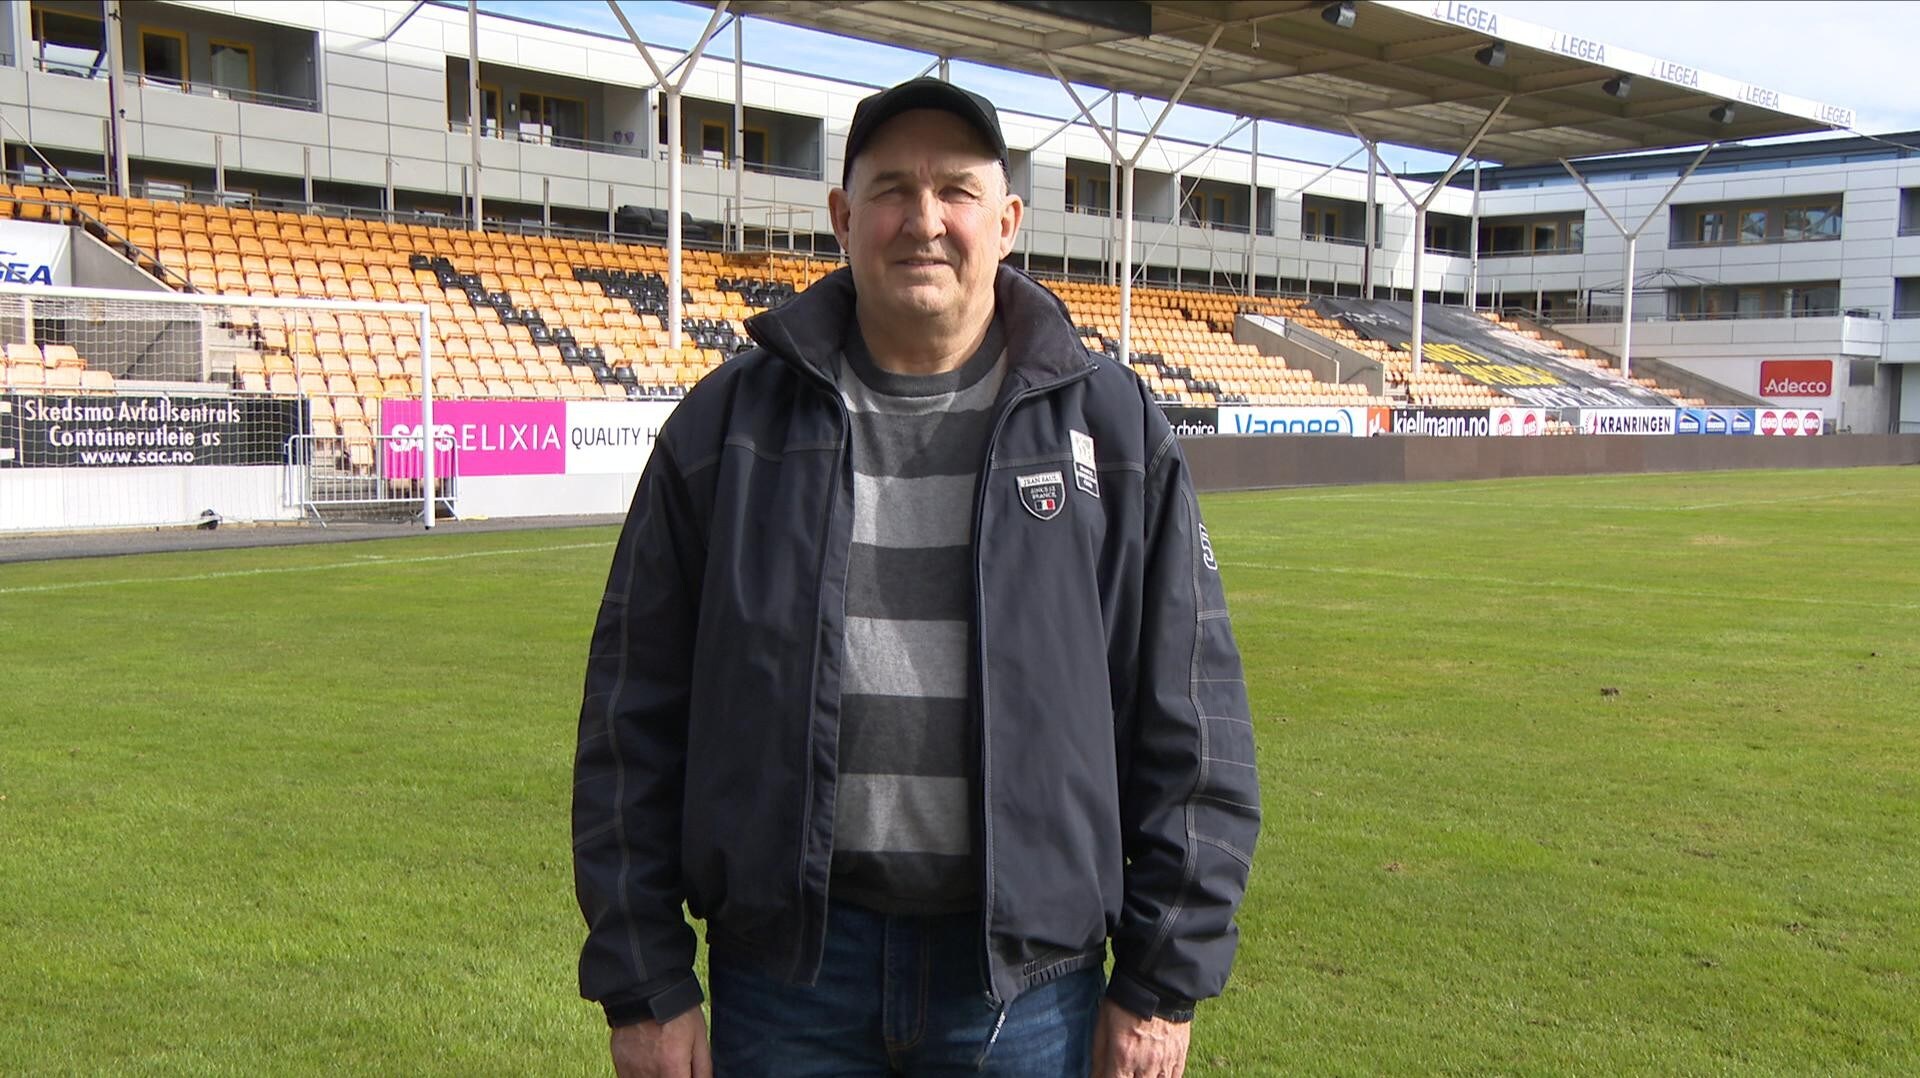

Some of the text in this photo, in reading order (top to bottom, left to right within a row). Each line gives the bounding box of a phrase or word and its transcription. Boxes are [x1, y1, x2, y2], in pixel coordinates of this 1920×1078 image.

[1446, 1, 1498, 34] LEGEA
[1561, 34, 1605, 63] LEGEA
[1660, 61, 1698, 88] LEGEA
[1746, 85, 1779, 109] LEGEA
[1821, 103, 1851, 125] LEGEA
[1764, 377, 1827, 393] Adecco
[24, 398, 241, 423] Skedsmo Avfallsentrals
[49, 424, 221, 446] Containerutleie as
[1600, 416, 1671, 433] KRANRINGEN
[462, 423, 561, 451] ELIXIA
[571, 427, 641, 450] QUALITY
[81, 450, 194, 464] www.sac.no
